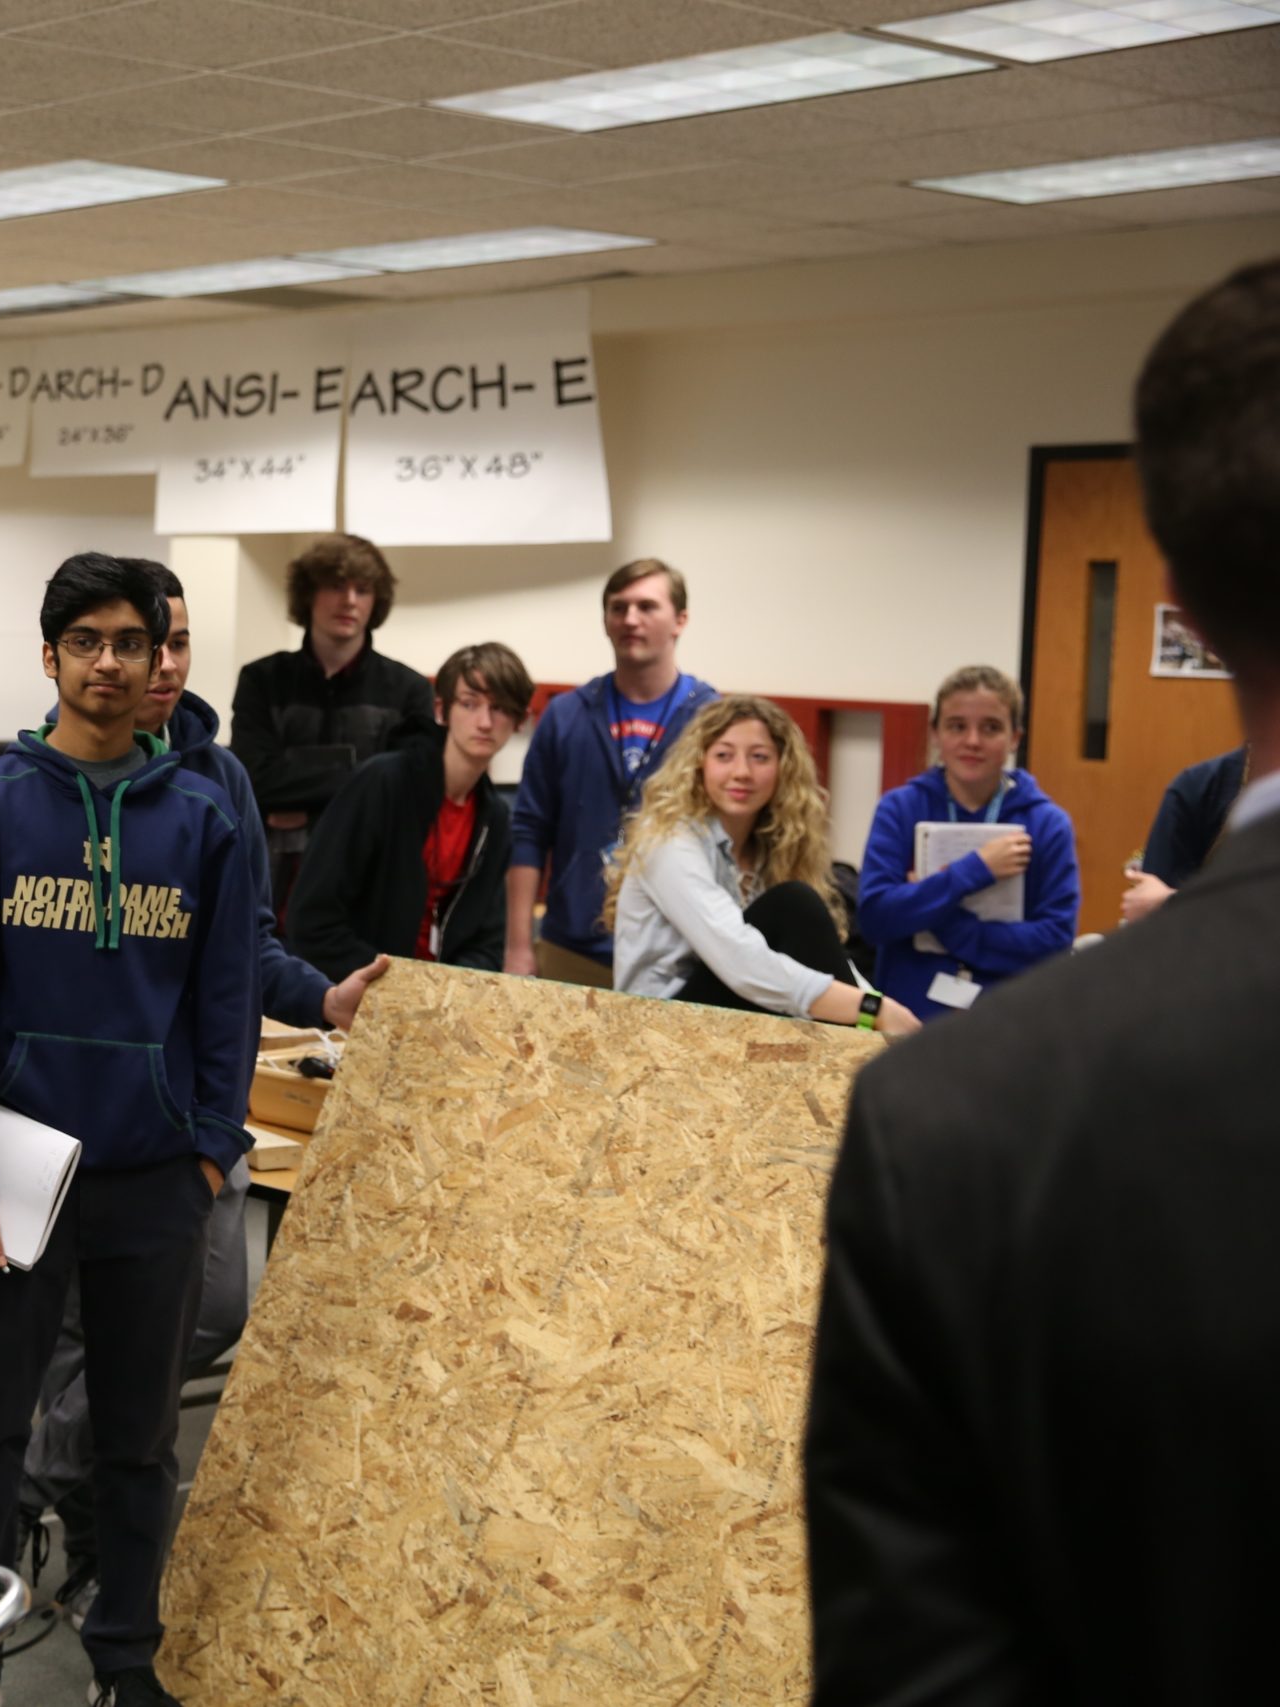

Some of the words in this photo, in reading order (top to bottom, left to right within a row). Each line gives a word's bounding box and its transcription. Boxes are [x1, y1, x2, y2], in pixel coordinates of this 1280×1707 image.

[9, 366, 31, 399] D
[30, 366, 134, 403] ARCH-
[141, 363, 166, 397] D
[163, 371, 300, 422] ANSI-
[312, 365, 344, 413] E
[350, 364, 536, 417] ARCH-
[553, 356, 595, 407] E
[13, 875, 102, 911] NOTR
[122, 905, 192, 938] IRISH
